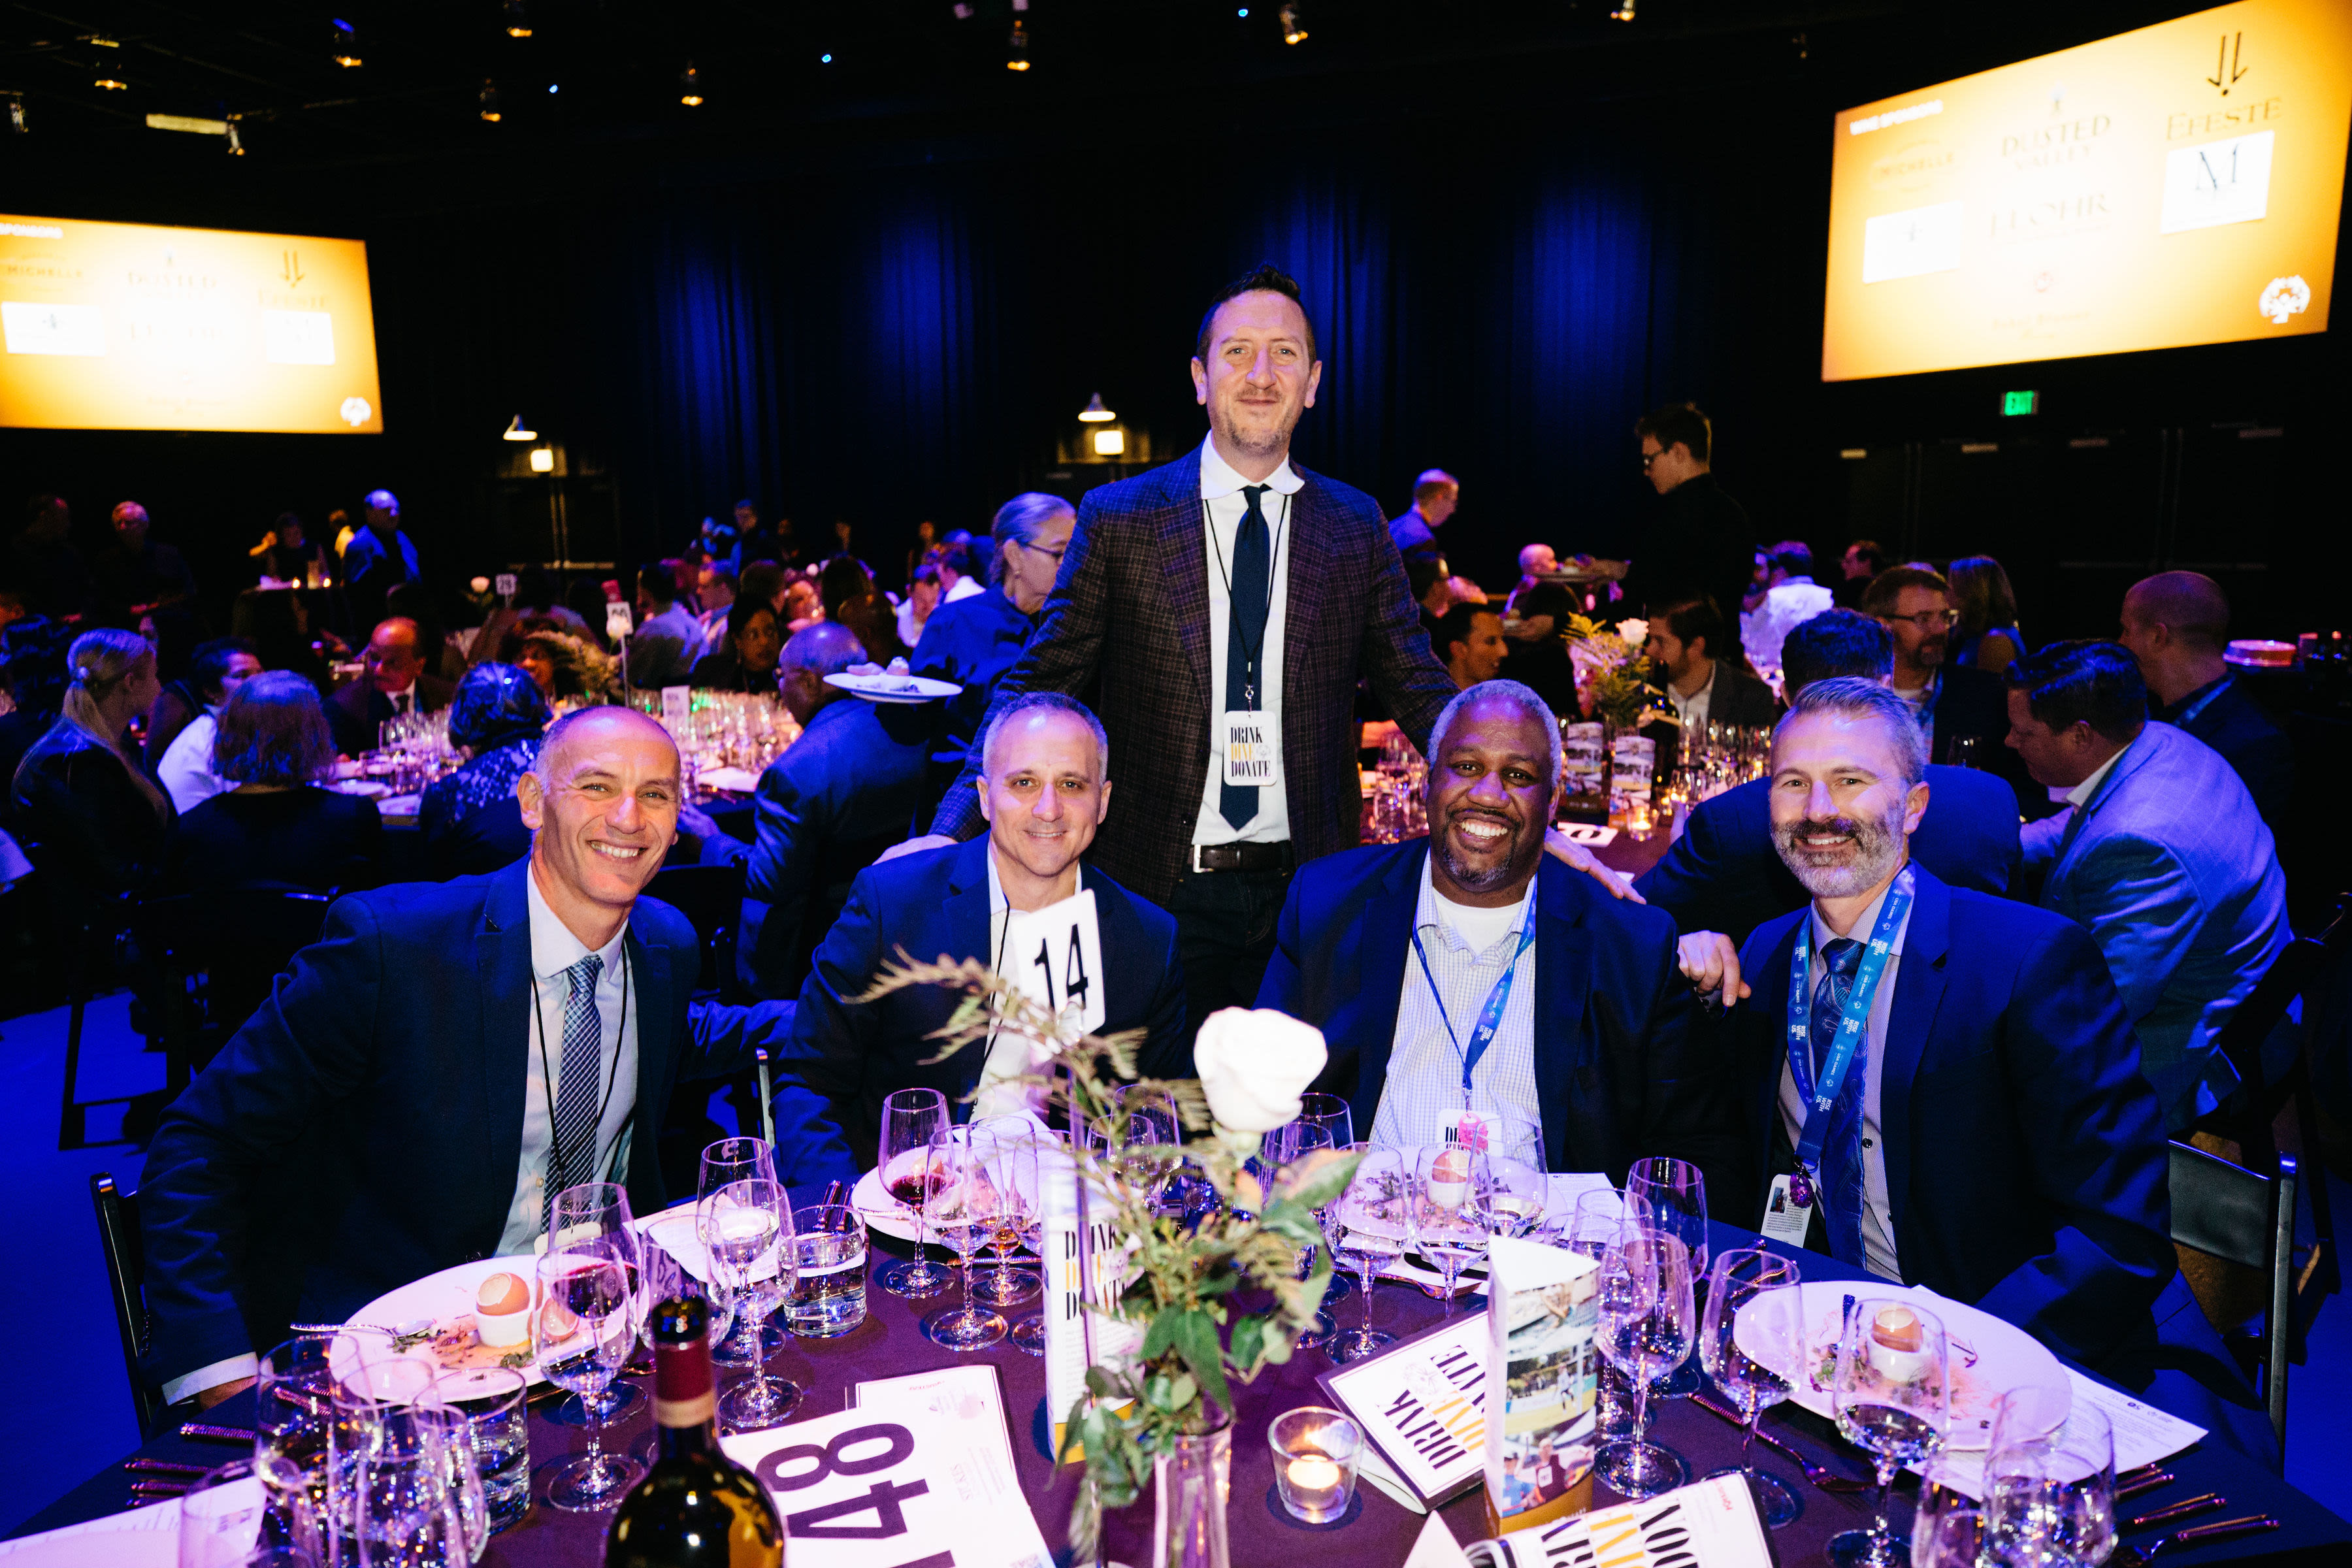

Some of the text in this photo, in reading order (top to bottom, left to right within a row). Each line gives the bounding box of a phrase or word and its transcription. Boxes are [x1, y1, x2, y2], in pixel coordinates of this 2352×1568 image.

[1880, 99, 1943, 128] SPONSORS
[2166, 97, 2282, 140] EFESTE
[2001, 114, 2111, 157] DUSTED
[1231, 727, 1262, 743] DRINK
[1231, 743, 1254, 760] DINE
[1232, 760, 1271, 777] DONATE
[1034, 923, 1088, 1011] 14
[1846, 1019, 1854, 1034] WITH
[1819, 1097, 1827, 1112] WITH
[1375, 1389, 1467, 1470] DRINK
